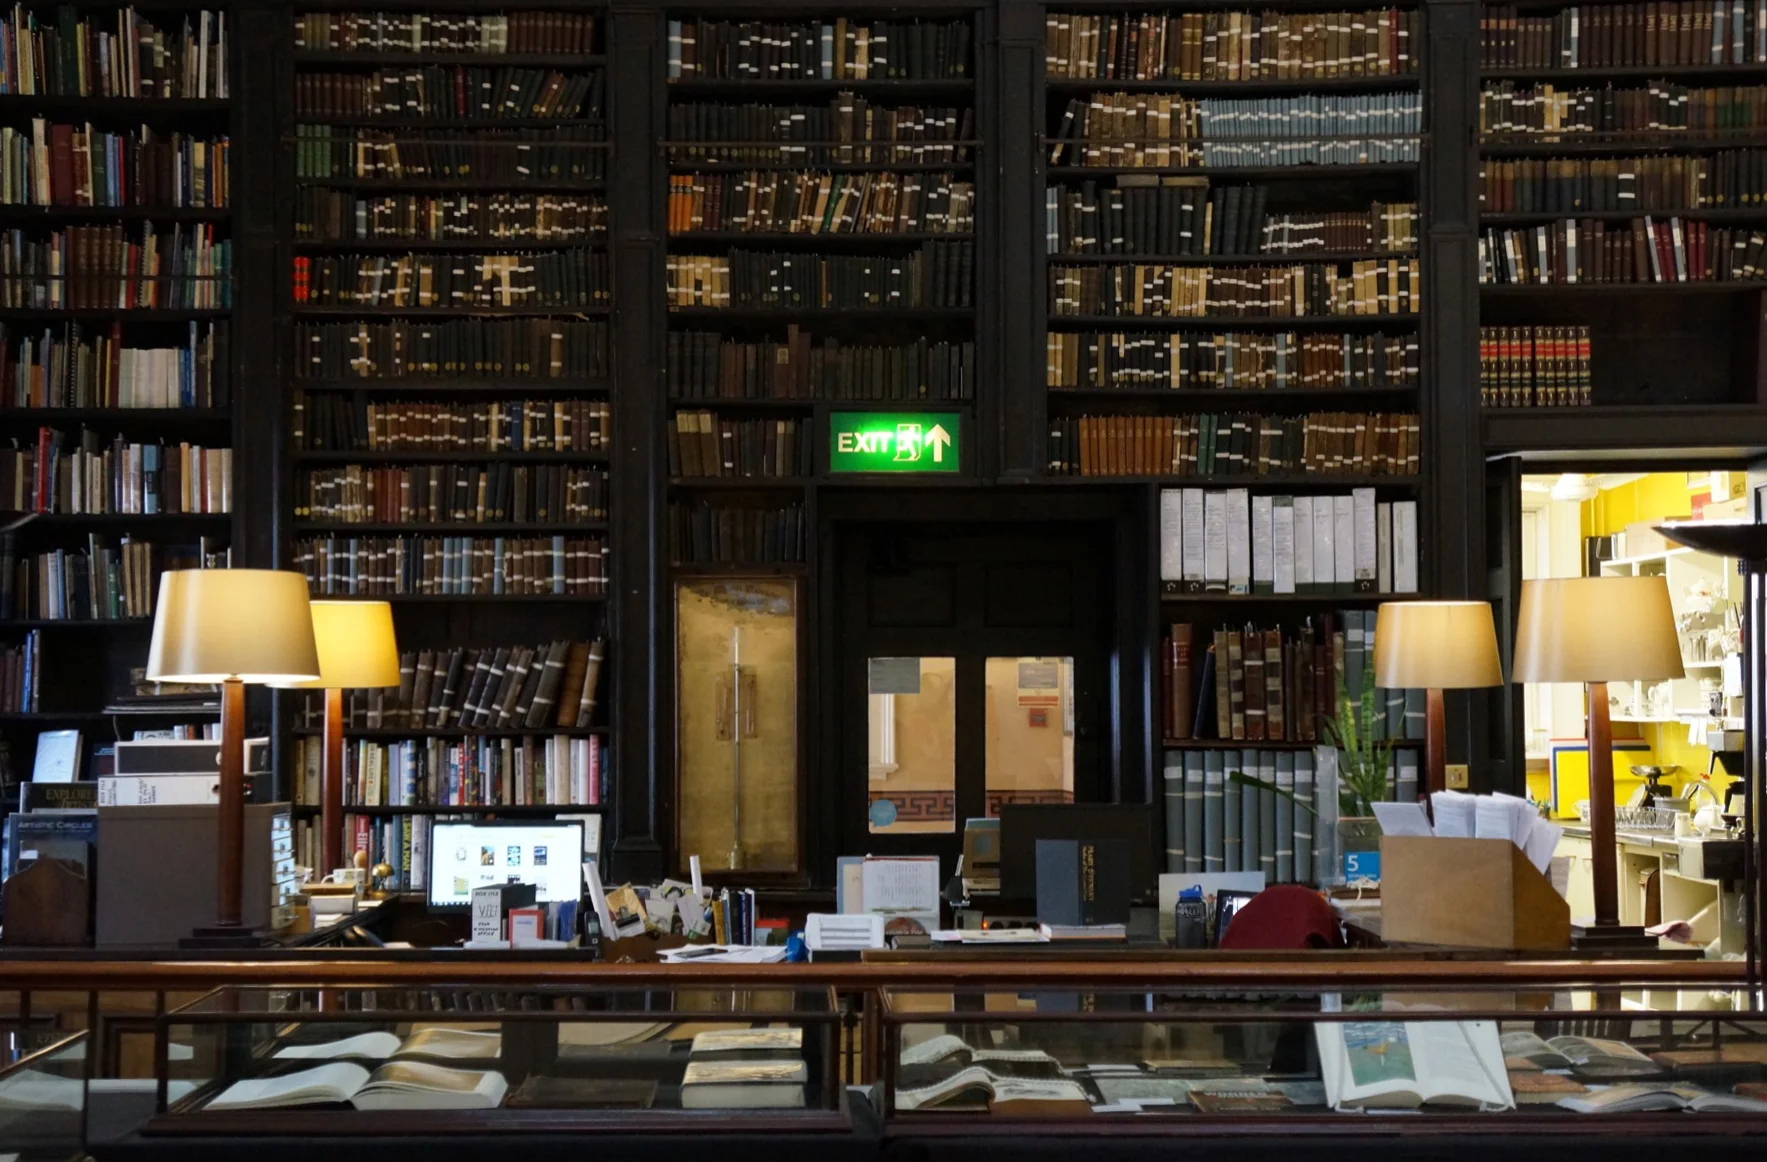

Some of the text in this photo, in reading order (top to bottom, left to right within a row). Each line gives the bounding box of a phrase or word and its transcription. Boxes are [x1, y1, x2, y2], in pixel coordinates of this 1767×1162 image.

[838, 432, 893, 453] EXIT
[56, 821, 92, 829] CIRCLES
[404, 822, 412, 841] SAW
[357, 832, 368, 851] Ellr
[404, 841, 411, 849] A
[1347, 855, 1359, 872] 5
